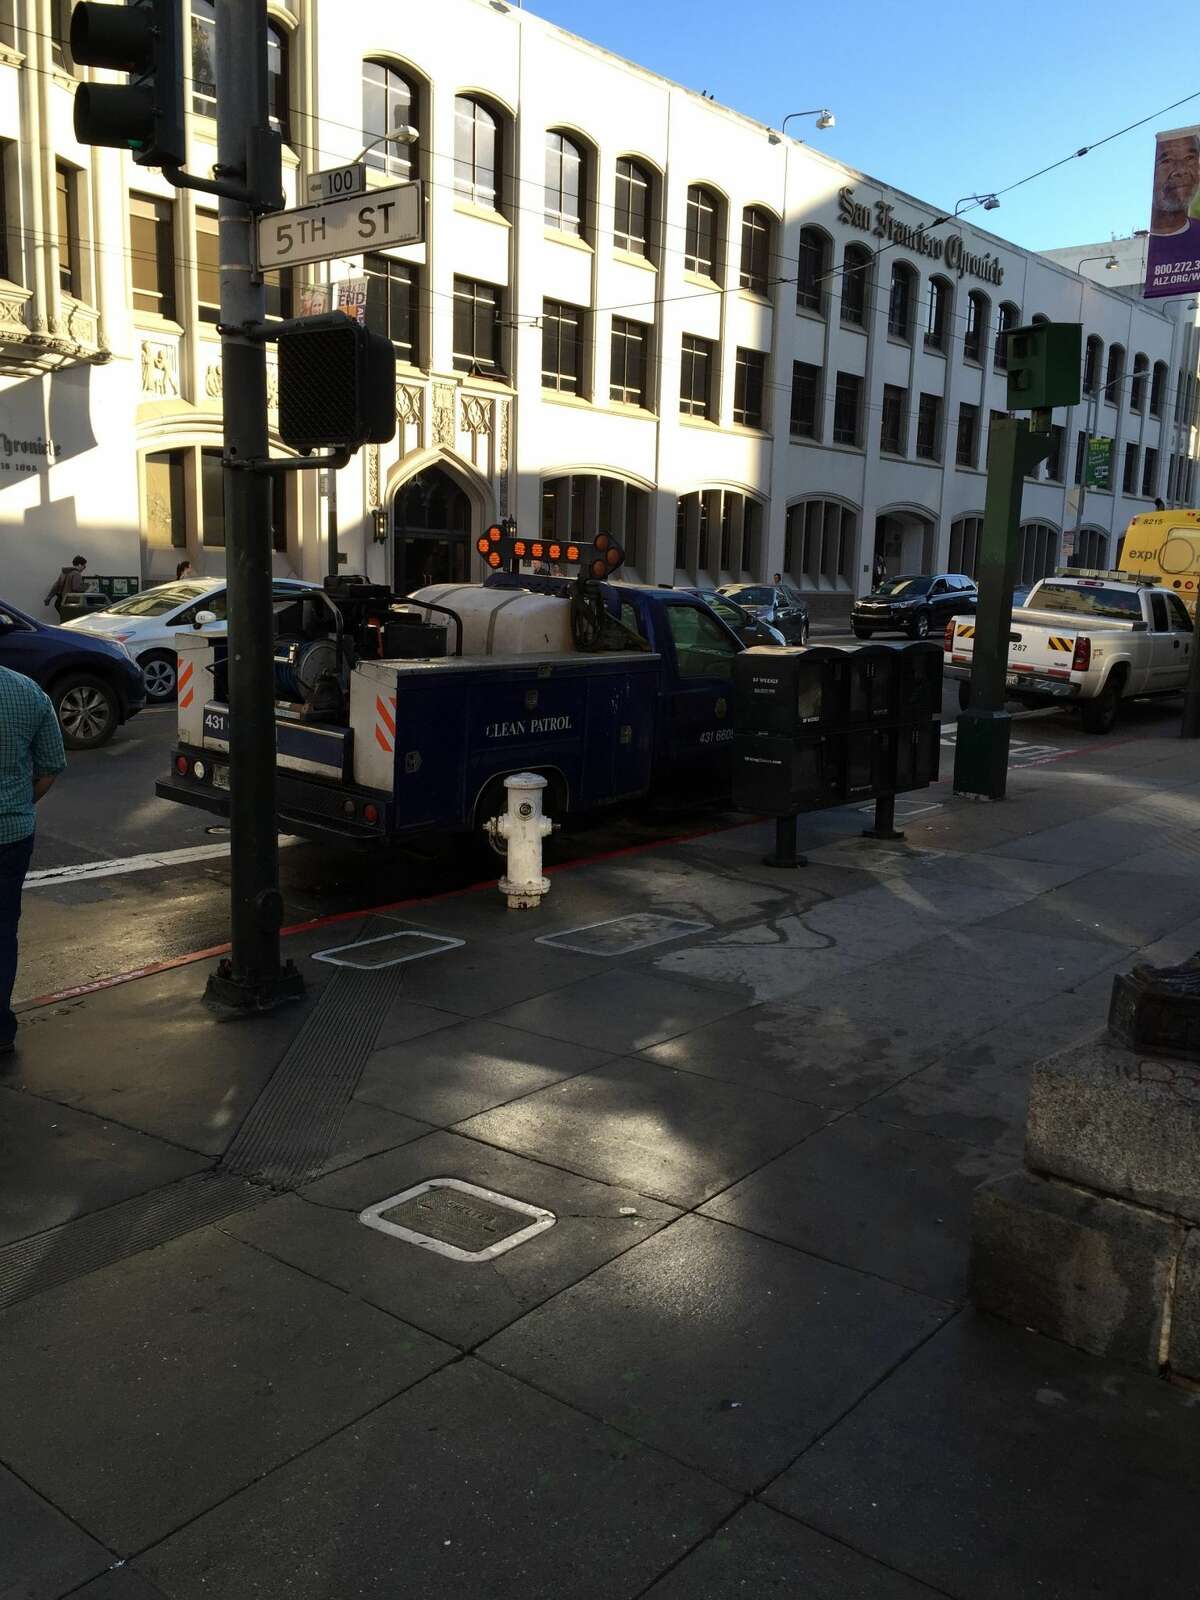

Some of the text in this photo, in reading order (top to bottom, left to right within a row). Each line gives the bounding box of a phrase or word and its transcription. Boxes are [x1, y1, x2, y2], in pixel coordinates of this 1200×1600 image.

[328, 169, 353, 195] 100
[838, 186, 872, 231] San
[276, 201, 396, 255] 5TH ST
[1154, 260, 1200, 276] 800.272.3
[1012, 643, 1028, 652] 287
[205, 713, 225, 730] 431
[486, 715, 572, 738] CLEAN PATROL
